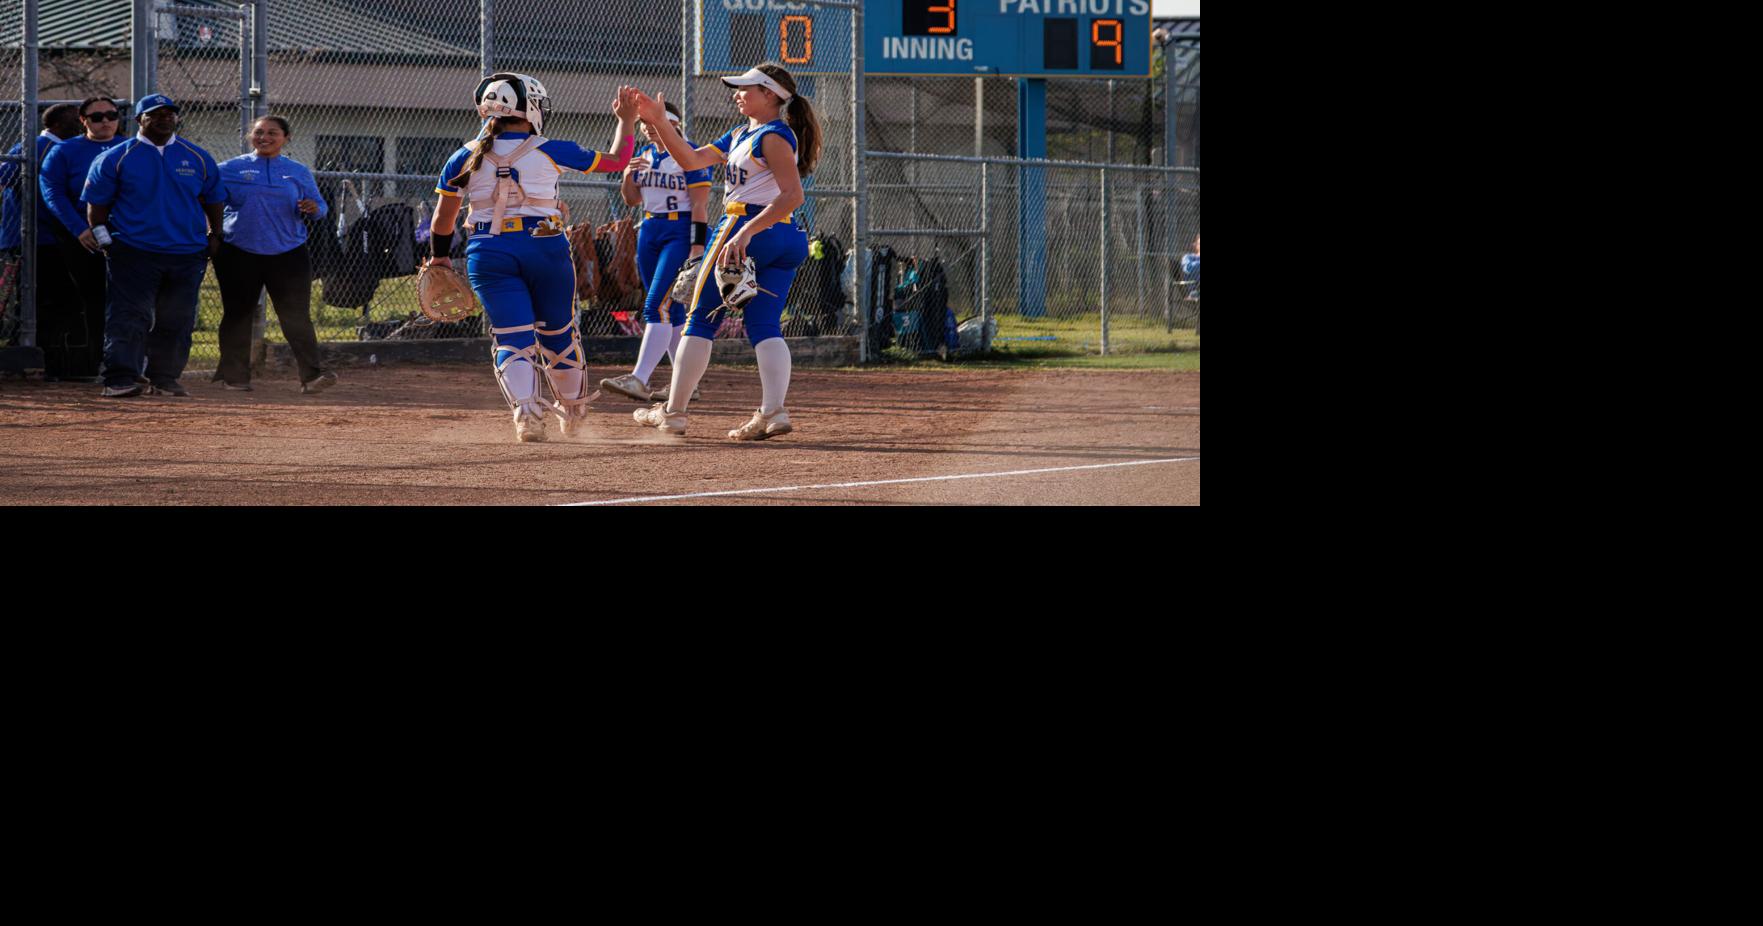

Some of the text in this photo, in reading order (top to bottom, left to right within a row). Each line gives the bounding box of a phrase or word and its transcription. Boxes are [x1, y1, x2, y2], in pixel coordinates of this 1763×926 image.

[928, 0, 955, 33] 3
[1000, 0, 1149, 15] PATRIOTS
[780, 15, 812, 64] 0
[883, 36, 974, 60] INNING
[1092, 19, 1122, 64] 9
[666, 195, 678, 211] 6
